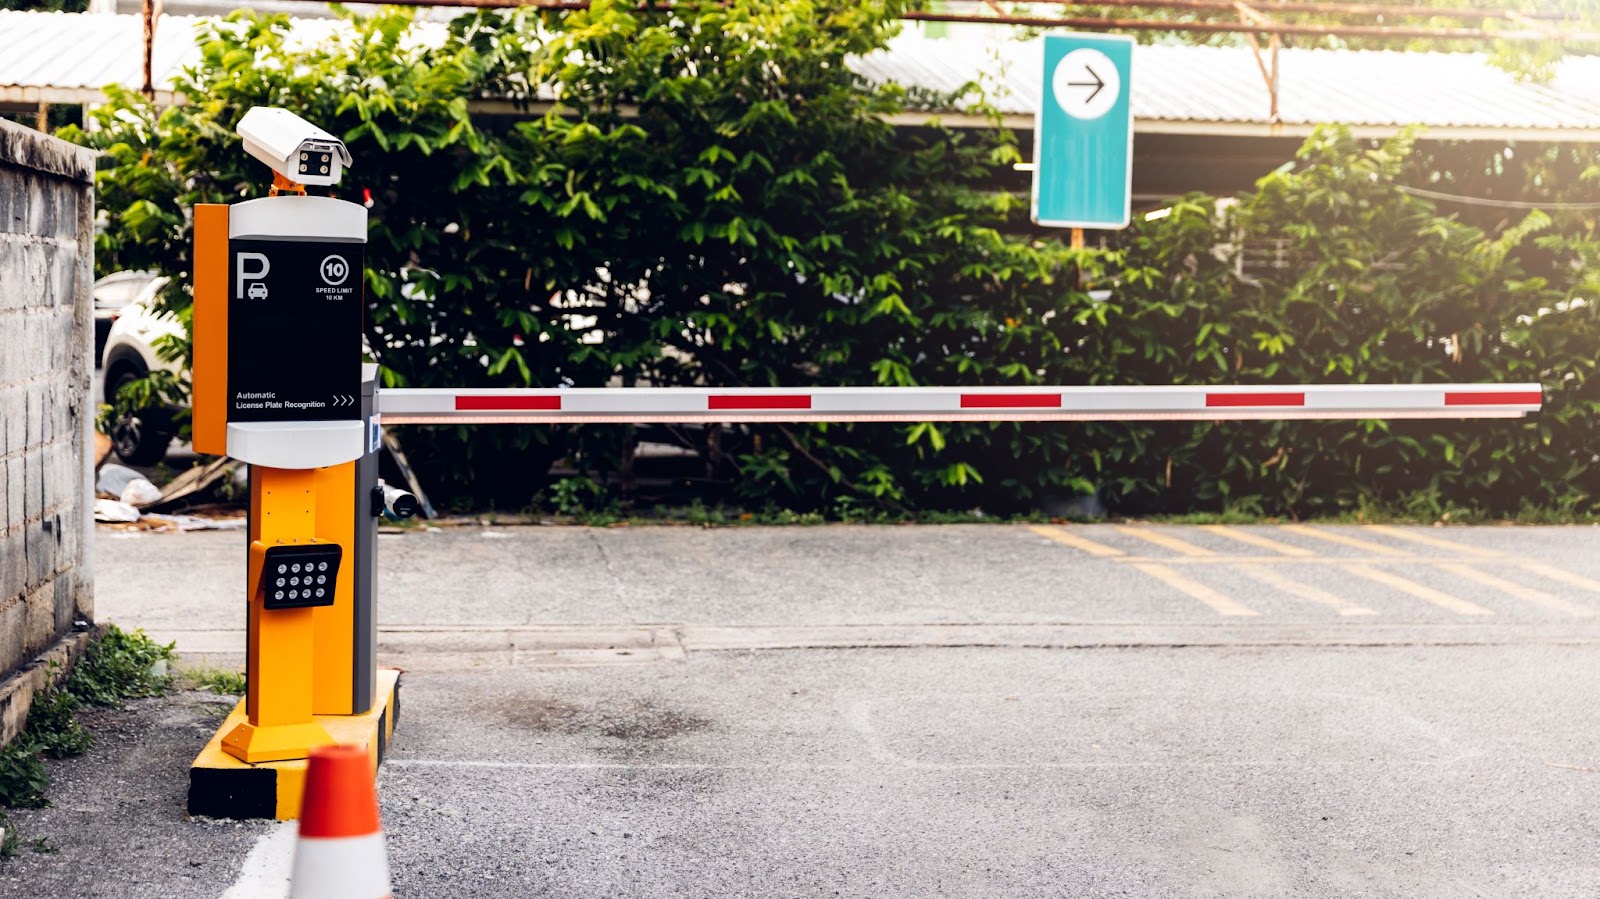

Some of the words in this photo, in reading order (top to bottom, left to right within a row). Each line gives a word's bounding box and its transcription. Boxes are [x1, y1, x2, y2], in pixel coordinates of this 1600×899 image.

[237, 252, 270, 299] P
[326, 263, 344, 277] 10
[236, 401, 264, 409] License
[265, 401, 282, 409] Plate
[284, 401, 325, 409] Recognition
